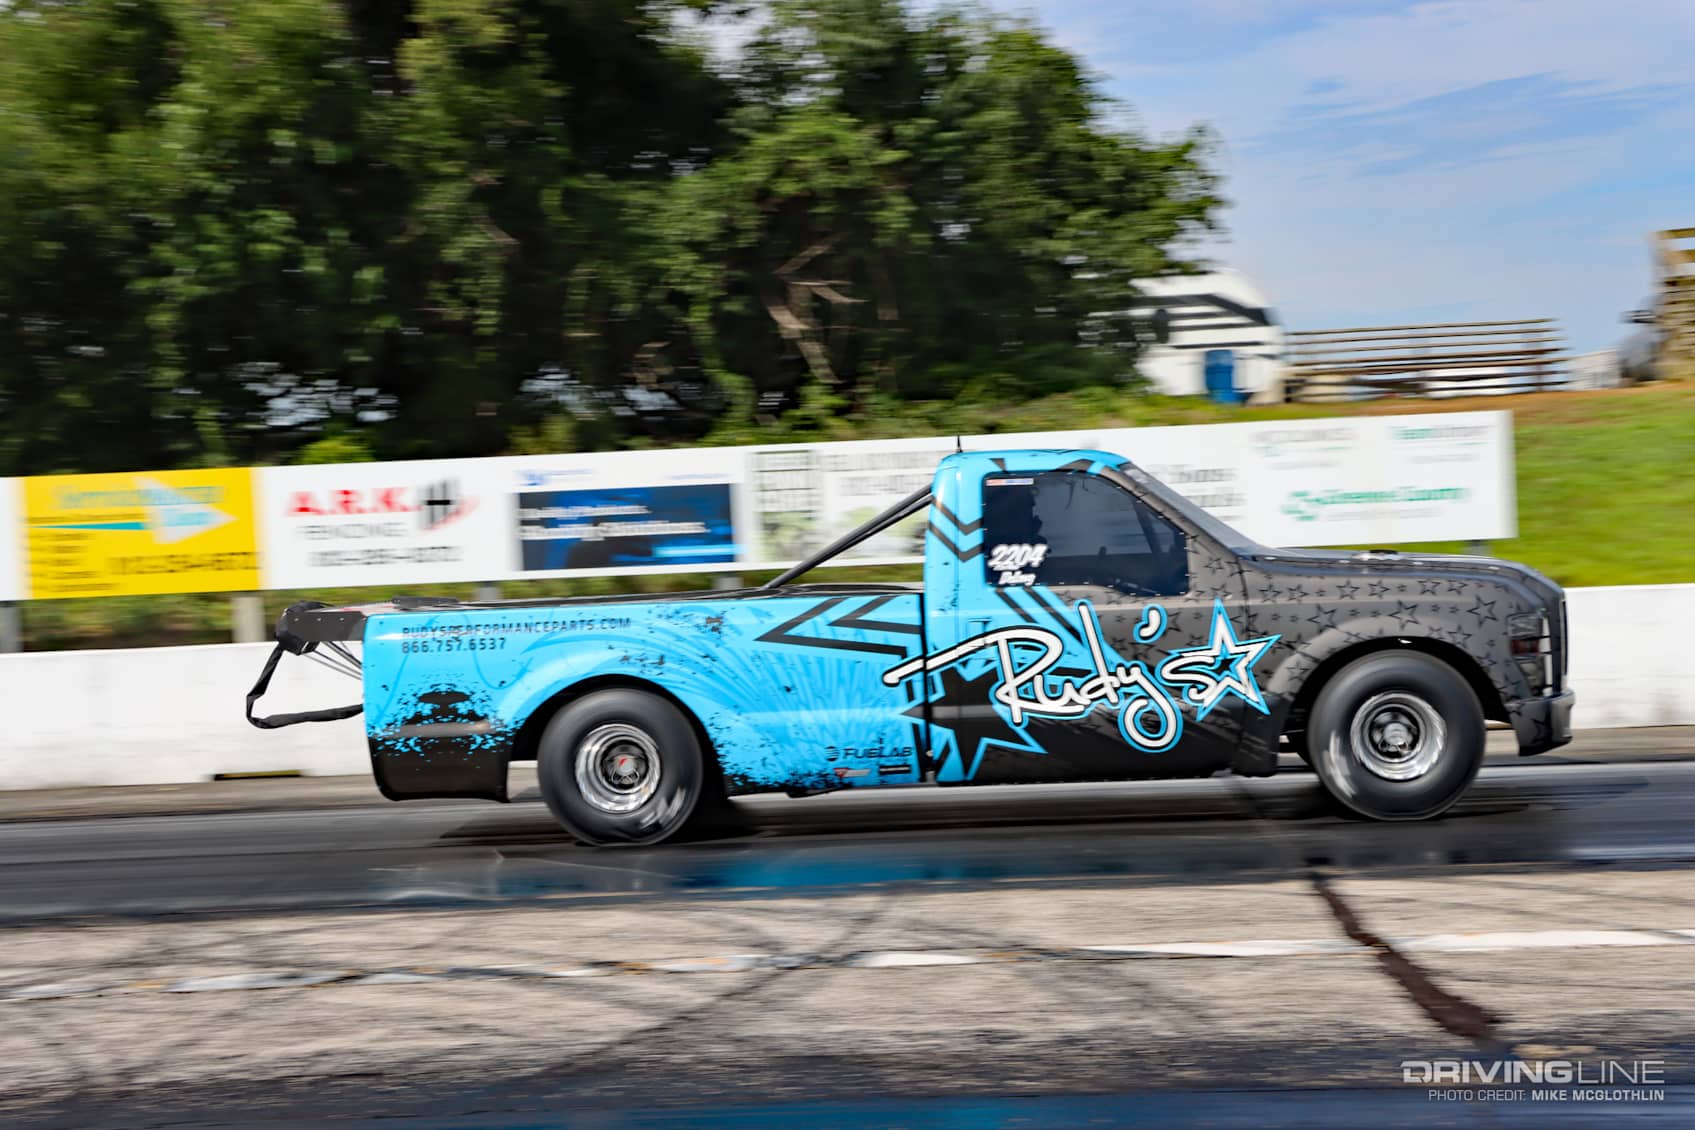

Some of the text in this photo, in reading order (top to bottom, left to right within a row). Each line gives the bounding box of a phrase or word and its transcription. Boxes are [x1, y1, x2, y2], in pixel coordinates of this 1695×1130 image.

[987, 544, 1048, 568] 2204
[402, 617, 632, 638] RUDYSPERFORMANCEPARTS.COM
[401, 637, 507, 654] 866.757.6537
[883, 599, 1281, 752] Rudy's
